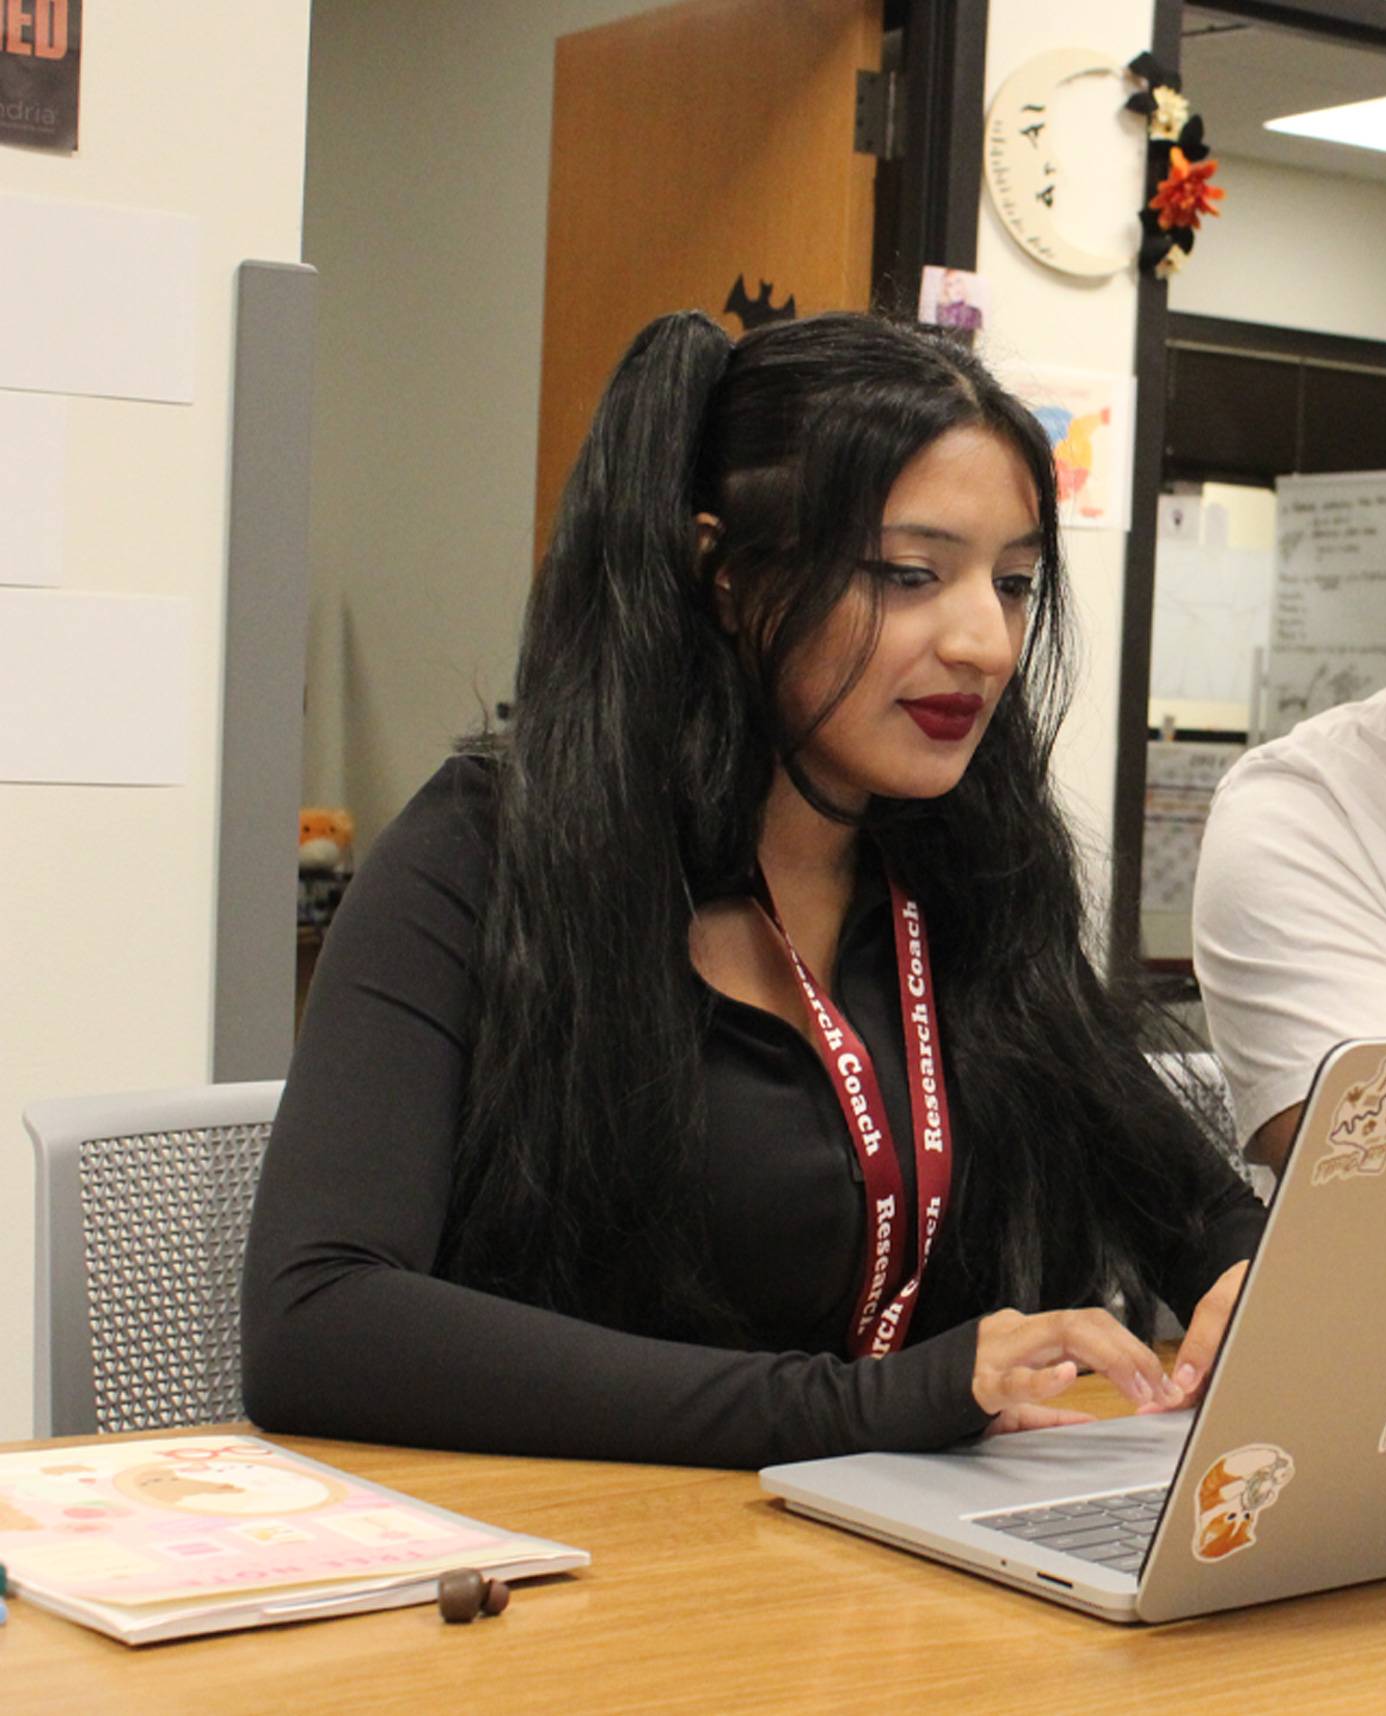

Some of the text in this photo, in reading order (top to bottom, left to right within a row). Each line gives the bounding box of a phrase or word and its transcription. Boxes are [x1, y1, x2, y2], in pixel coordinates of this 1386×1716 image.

[0, 0, 68, 59] ED
[902, 900, 945, 1153] Research Coach
[836, 1052, 880, 1157] Coach
